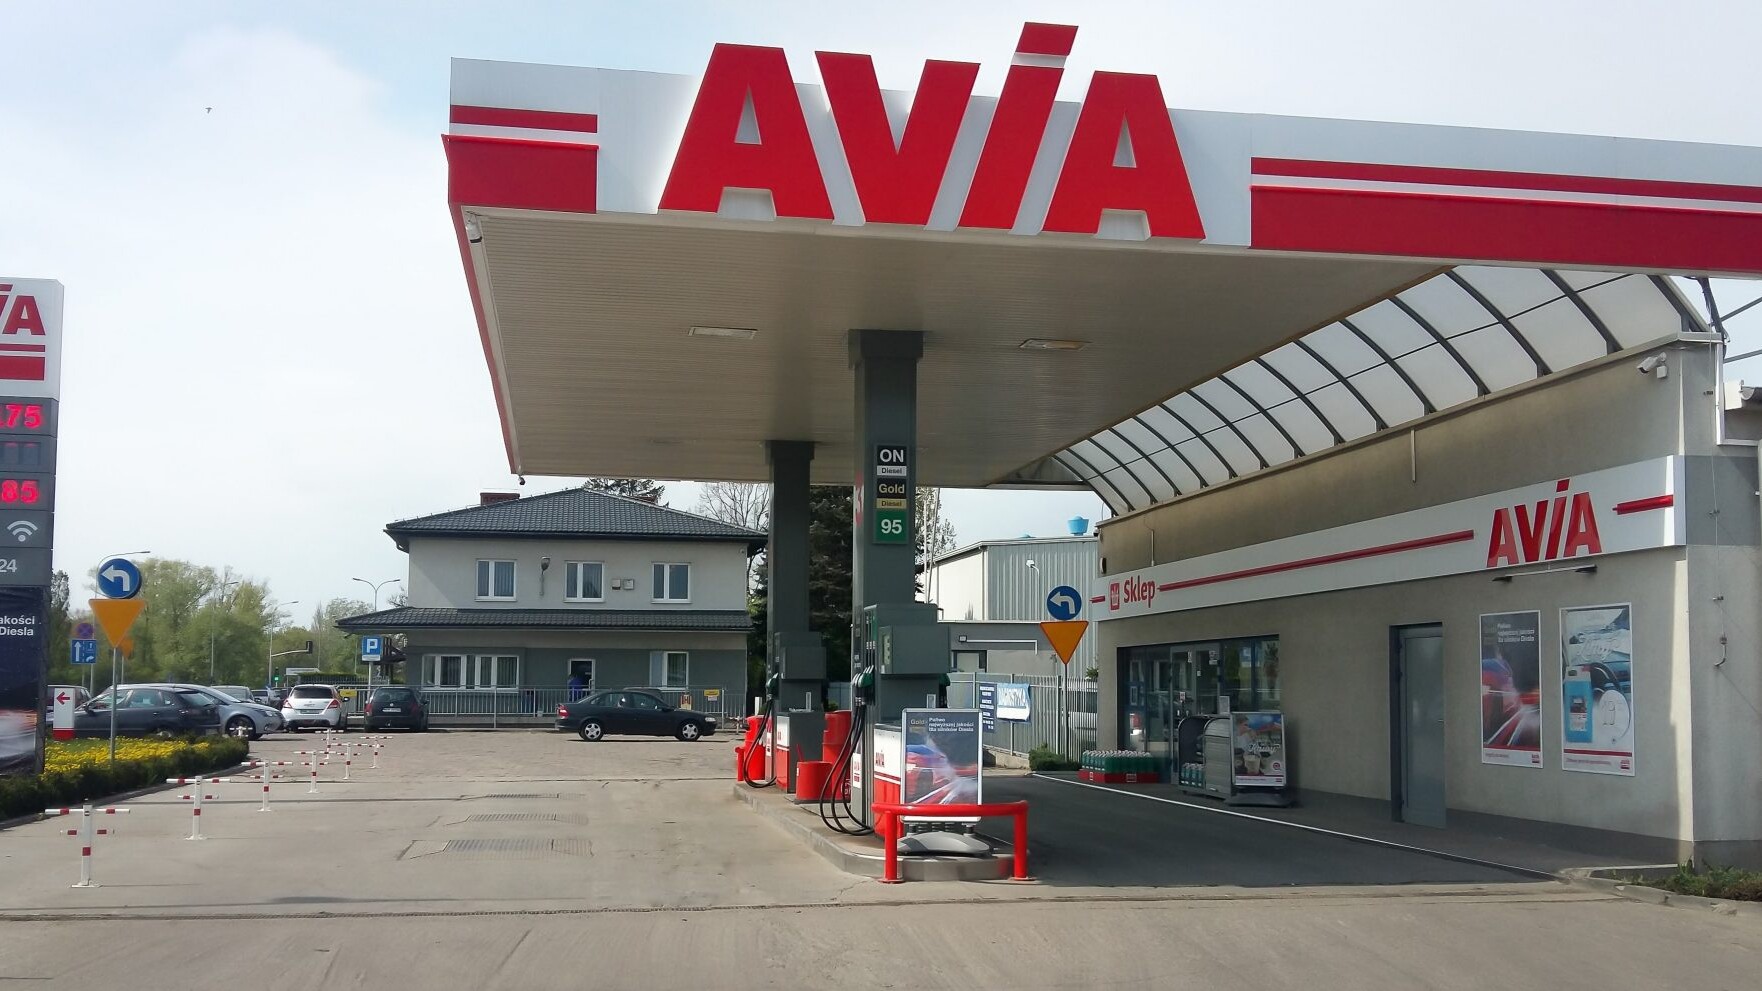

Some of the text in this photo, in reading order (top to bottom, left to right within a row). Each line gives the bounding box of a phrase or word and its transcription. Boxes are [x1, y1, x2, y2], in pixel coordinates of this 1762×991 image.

[879, 448, 904, 463] ON
[878, 483, 905, 494] Gold
[880, 518, 903, 534] 95
[0, 558, 17, 573] 24
[1123, 574, 1156, 608] Sklep
[0, 626, 34, 636] Diesla
[366, 638, 378, 653] P
